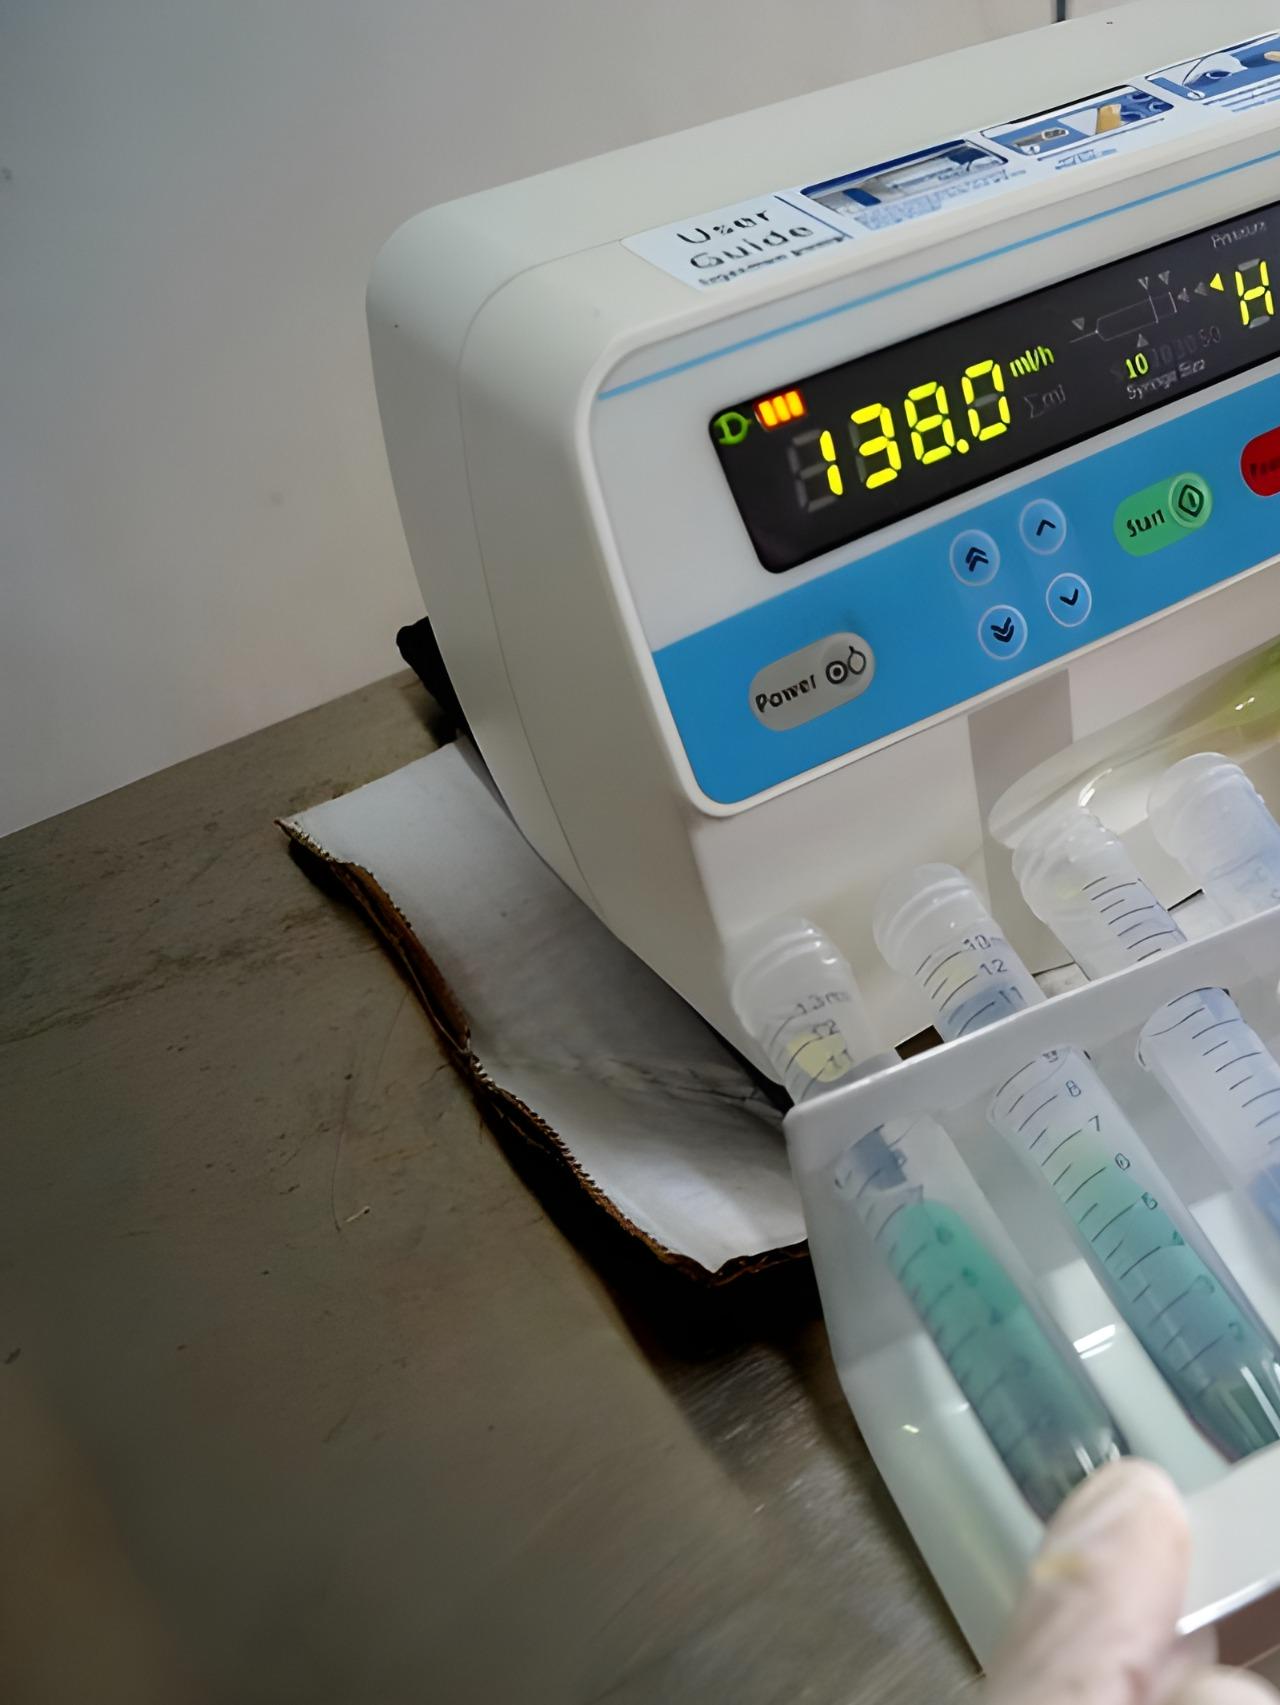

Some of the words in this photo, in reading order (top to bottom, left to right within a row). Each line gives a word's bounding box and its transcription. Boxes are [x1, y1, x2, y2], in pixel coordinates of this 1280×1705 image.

[676, 209, 771, 244] User
[690, 226, 814, 269] Guide
[1125, 352, 1149, 379] 10
[818, 359, 1011, 496] 138.0
[755, 674, 817, 713] Power
[979, 958, 1008, 976] 12
[1065, 1079, 1082, 1098] 8
[1088, 1114, 1101, 1132] 7
